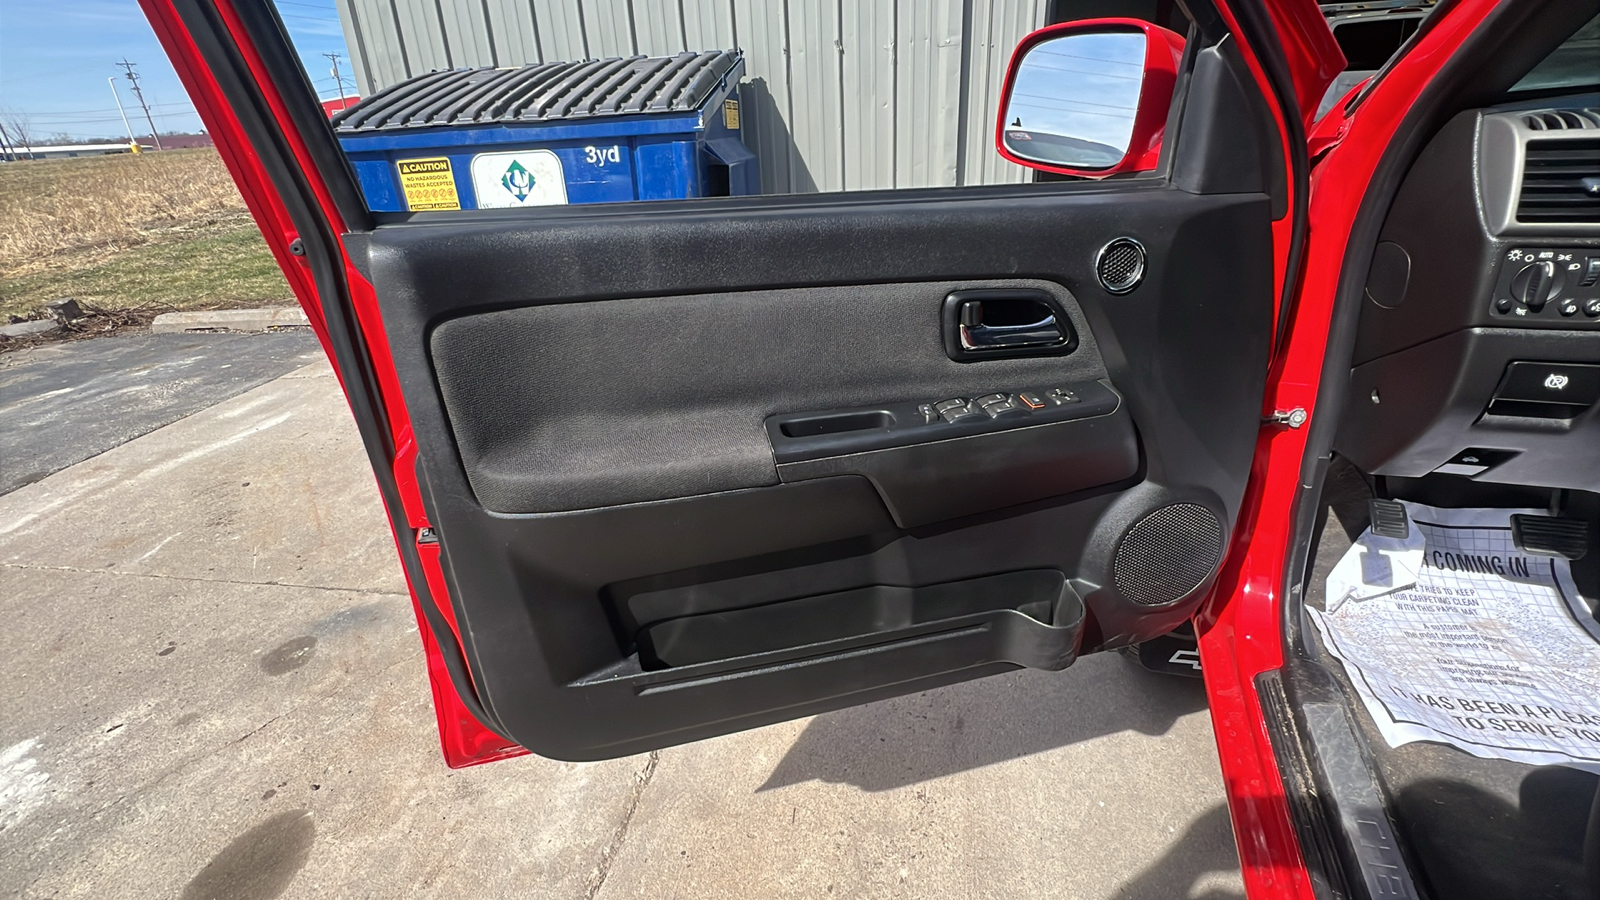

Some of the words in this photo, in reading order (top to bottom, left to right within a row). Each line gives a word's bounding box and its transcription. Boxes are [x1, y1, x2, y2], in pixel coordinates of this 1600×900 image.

[585, 145, 620, 167] 3yd
[409, 162, 447, 172] CAUTION
[1432, 550, 1506, 576] COMING
[1508, 556, 1530, 578] IN
[1420, 585, 1442, 594] TRIED
[1442, 587, 1453, 596] TO
[1455, 588, 1475, 597] KEEP
[1409, 593, 1451, 605] CARPETING
[1452, 597, 1480, 606] CLEAN
[1395, 602, 1416, 611] WITH
[1416, 605, 1435, 613] THIS
[1461, 608, 1478, 616] MAT
[1440, 633, 1479, 641] important
[1435, 657, 1454, 665] Your
[1388, 685, 1408, 698] IT
[1410, 692, 1455, 710] HAS
[1457, 698, 1520, 716] BEEN
[1521, 704, 1539, 718] A
[1452, 715, 1486, 731] TO
[1488, 718, 1566, 739] SERVE
